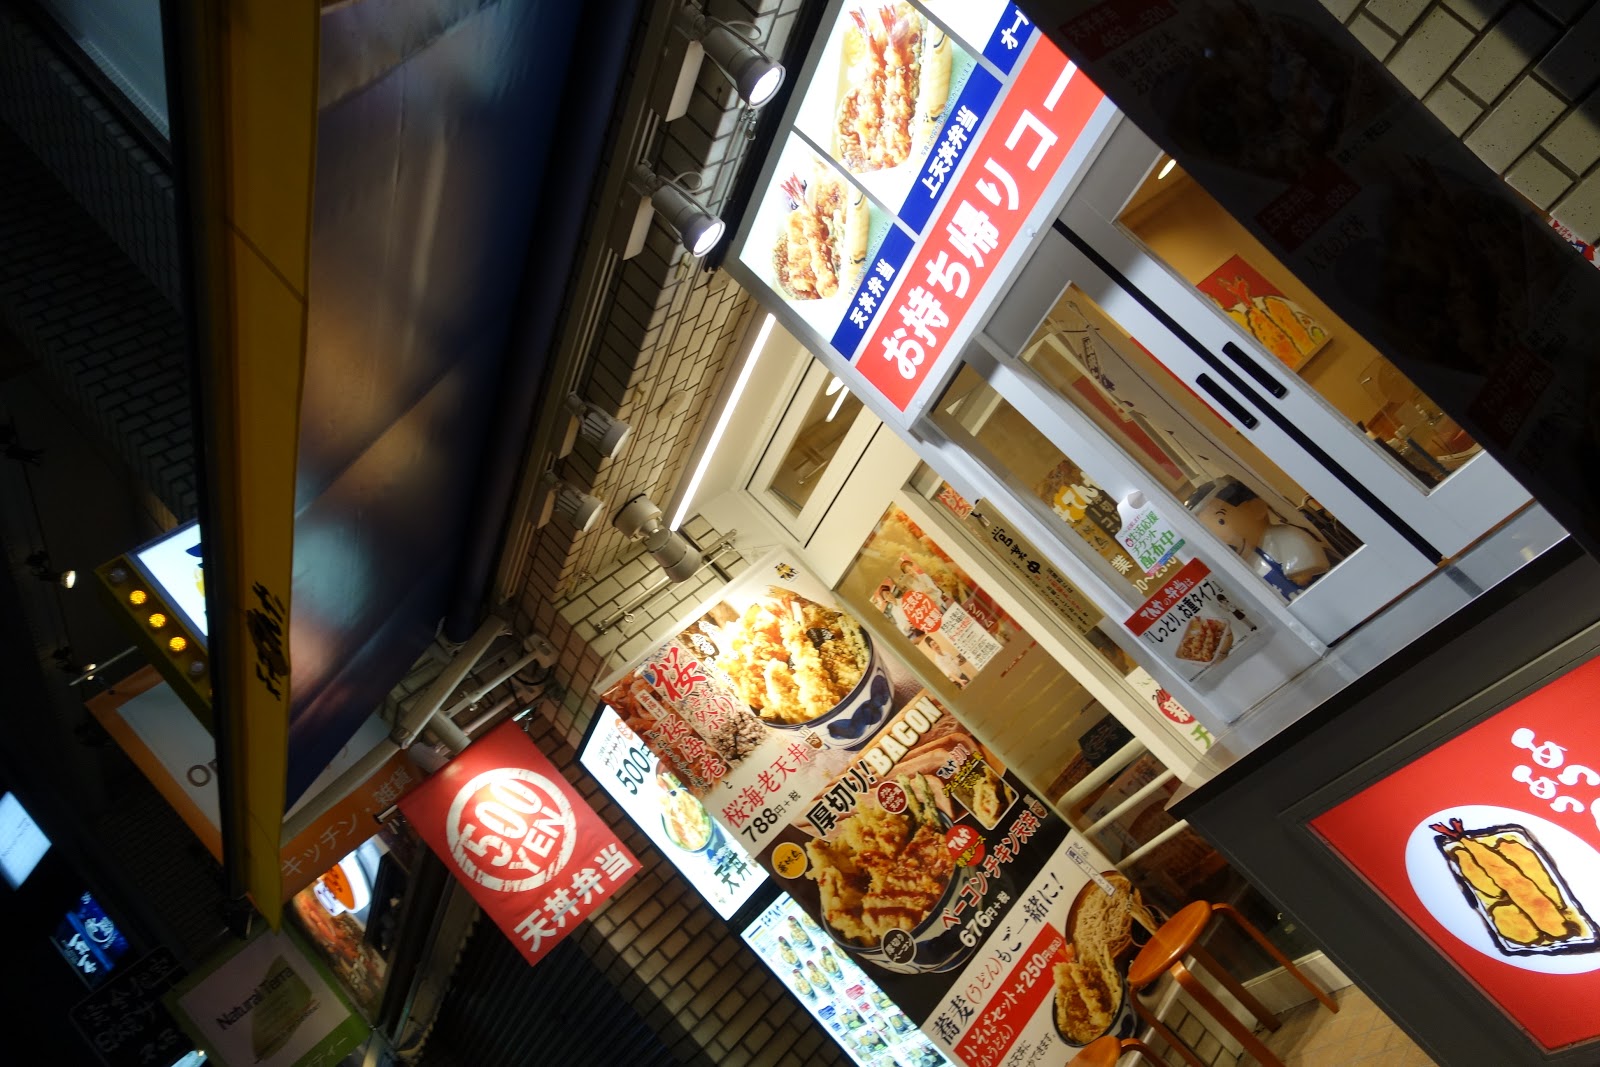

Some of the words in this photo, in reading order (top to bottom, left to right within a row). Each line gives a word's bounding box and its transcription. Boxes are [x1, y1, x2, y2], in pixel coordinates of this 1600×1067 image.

[921, 105, 979, 199] 上天丼弁当
[881, 59, 1078, 380] お持ち帰りコー
[849, 257, 896, 330] 天丼弁当
[991, 525, 1041, 575] 営業中
[1131, 528, 1159, 556] チケット
[1137, 528, 1178, 570] 配布中
[901, 589, 925, 616] 元気な
[910, 599, 934, 625] スタッフ
[1139, 573, 1195, 623] てんやの弁当は
[651, 647, 707, 702] 桜
[692, 691, 738, 734] 祭り
[862, 692, 945, 779] BACON
[656, 710, 729, 785] 桜海老
[720, 737, 814, 832] 桜海老天丼
[803, 758, 879, 838] 厚切り!
[281, 766, 414, 879] キッチン・雑貨
[456, 774, 543, 869] 500
[508, 811, 570, 878] YEN
[946, 825, 973, 852] てんや
[513, 841, 635, 953] 天丼弁当
[935, 810, 1043, 933] ベーコン・チキン天丼
[883, 931, 906, 956] 厚切り
[892, 937, 914, 962] ベーコン
[215, 986, 263, 1032] Natural
